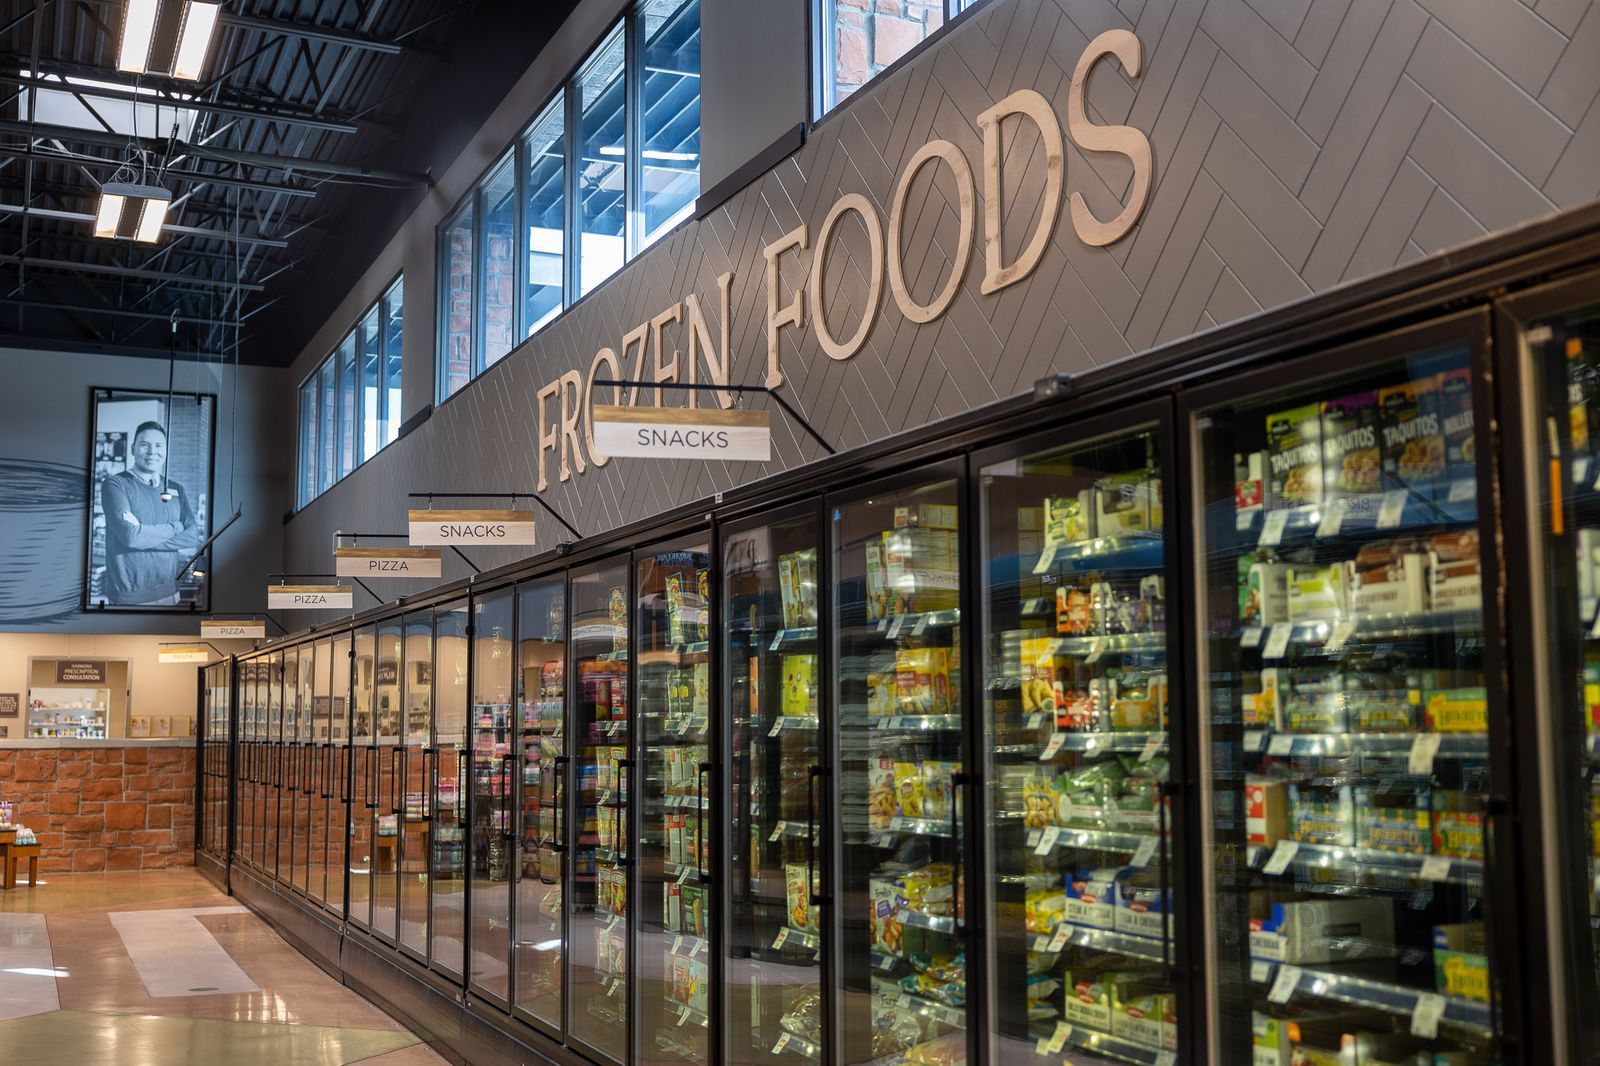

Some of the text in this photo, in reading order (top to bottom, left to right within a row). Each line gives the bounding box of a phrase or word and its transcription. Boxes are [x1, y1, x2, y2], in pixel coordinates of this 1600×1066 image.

[537, 29, 1152, 492] FROZEN FOODS
[1382, 413, 1438, 447] TAQUITOS
[637, 429, 729, 448] SNACKS
[440, 525, 506, 538] SNACKS
[369, 560, 409, 571] PIZZA
[294, 595, 327, 604] PIZZA
[220, 627, 246, 635] PIZZA
